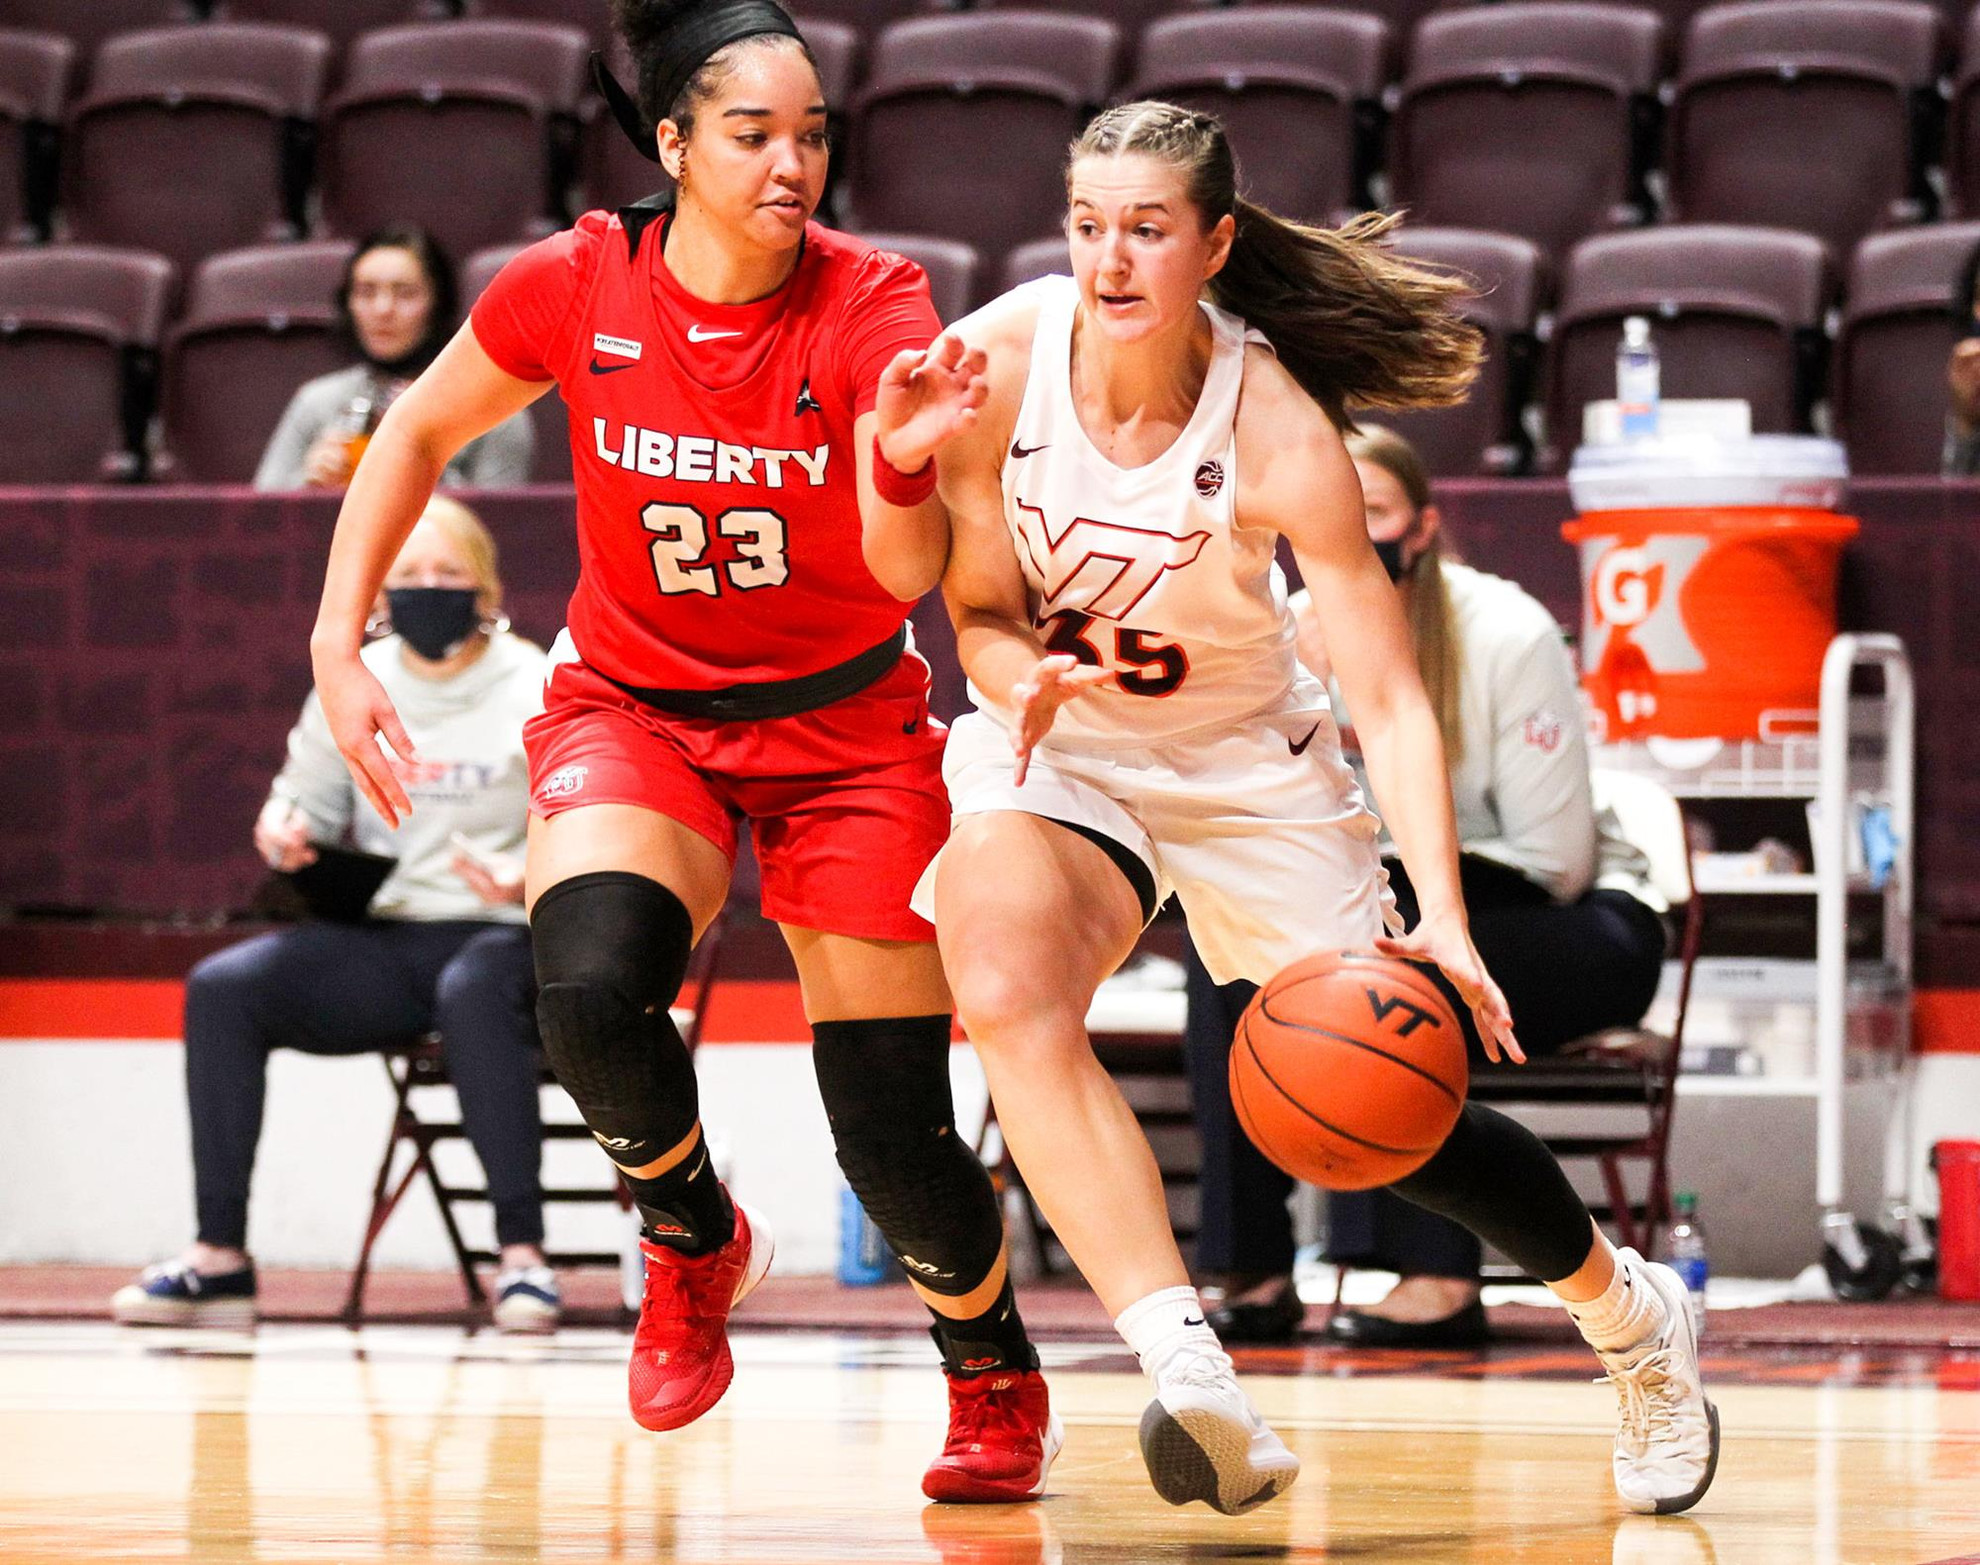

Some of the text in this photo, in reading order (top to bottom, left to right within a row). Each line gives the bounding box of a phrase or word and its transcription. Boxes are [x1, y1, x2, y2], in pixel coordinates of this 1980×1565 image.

[592, 416, 830, 489] LIBERTY
[639, 500, 790, 598] 23
[1015, 497, 1213, 622] VT
[1597, 549, 1651, 627] G
[1366, 987, 1441, 1038] VT
